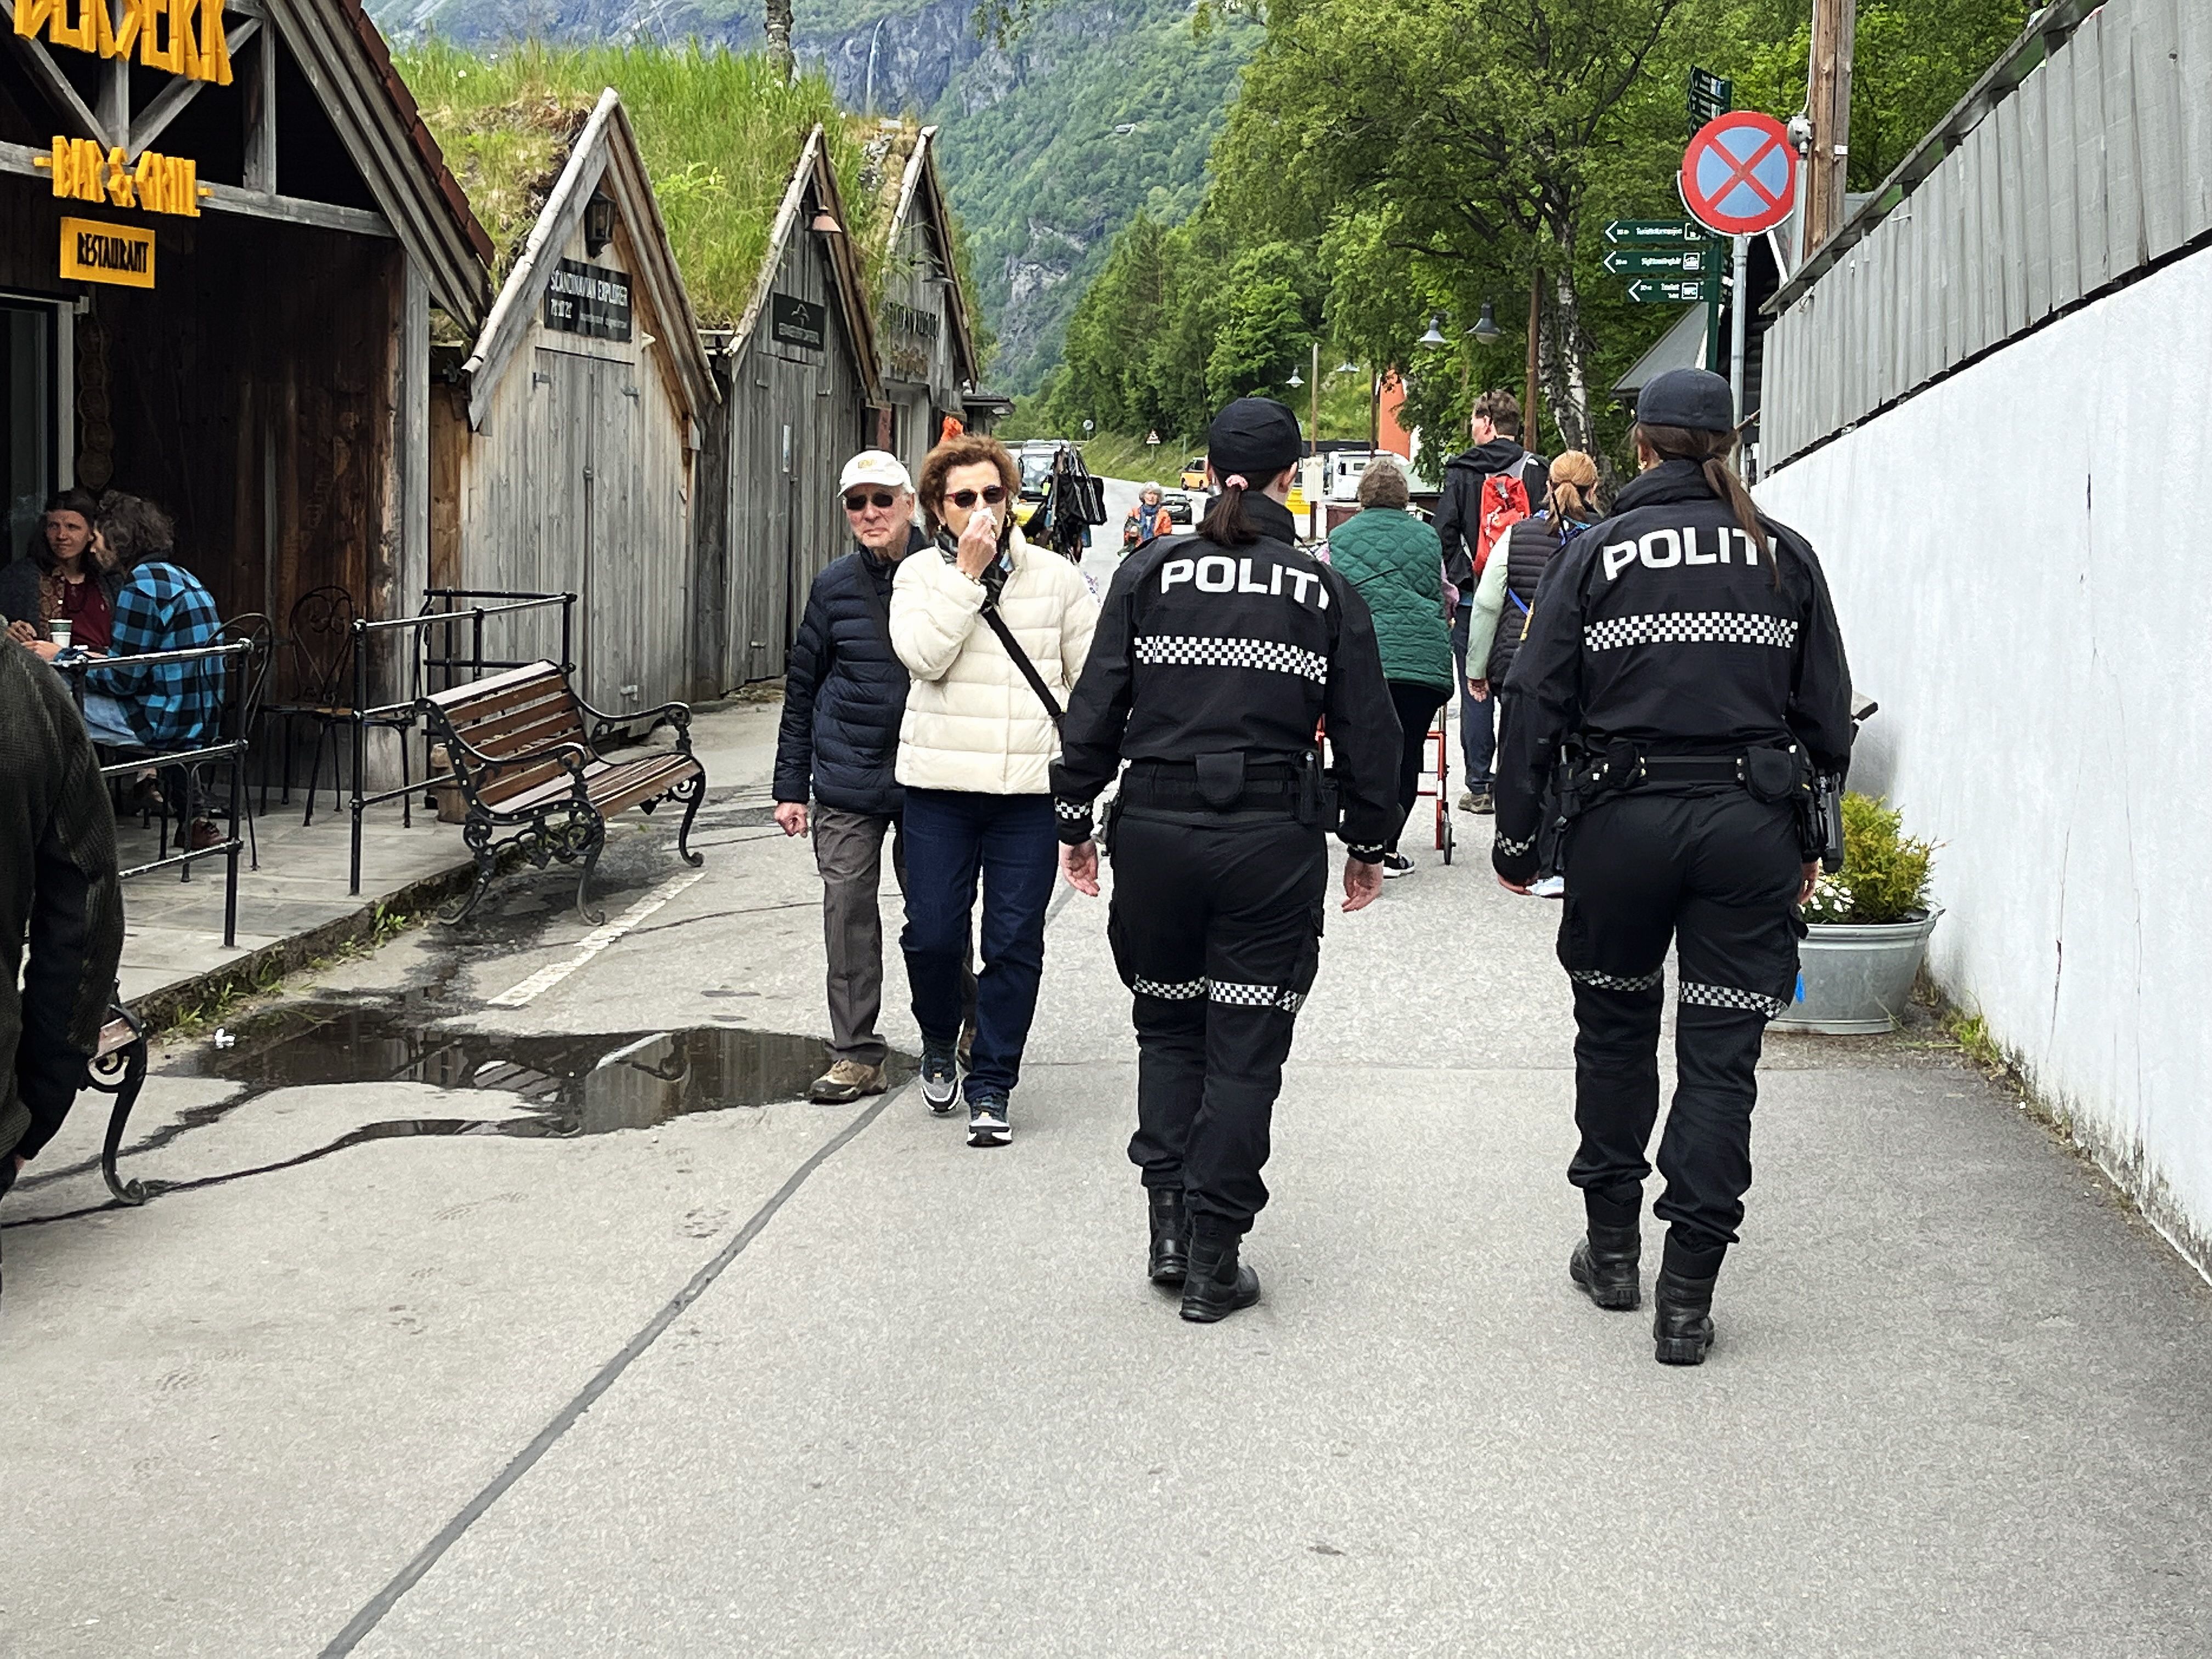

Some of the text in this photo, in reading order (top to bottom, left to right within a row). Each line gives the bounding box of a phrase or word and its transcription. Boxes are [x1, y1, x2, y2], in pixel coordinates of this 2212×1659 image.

[52, 135, 201, 217] BAR & GRILL
[77, 232, 149, 274] RESTAURANT
[1161, 555, 1330, 610] POLITI
